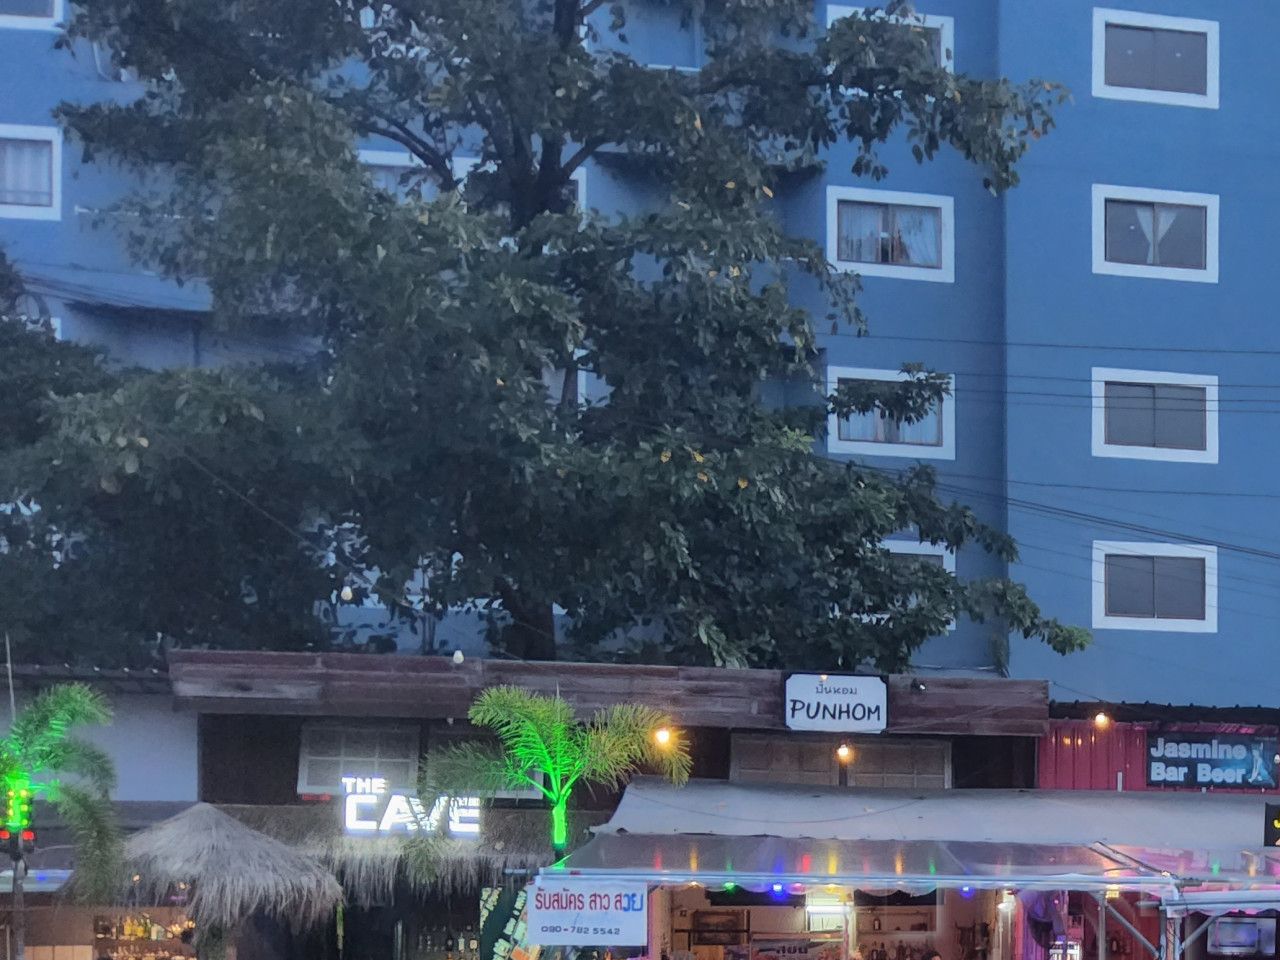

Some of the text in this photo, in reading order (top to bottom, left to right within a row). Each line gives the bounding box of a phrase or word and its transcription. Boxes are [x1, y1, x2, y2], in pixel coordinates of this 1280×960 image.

[789, 699, 881, 721] PUNHOM
[1150, 737, 1247, 760] Jasmine
[1150, 762, 1247, 783] Bar Beer
[341, 777, 386, 793] THE
[345, 794, 481, 832] CAVE
[535, 887, 644, 913] รับสมัคร สาว สวย
